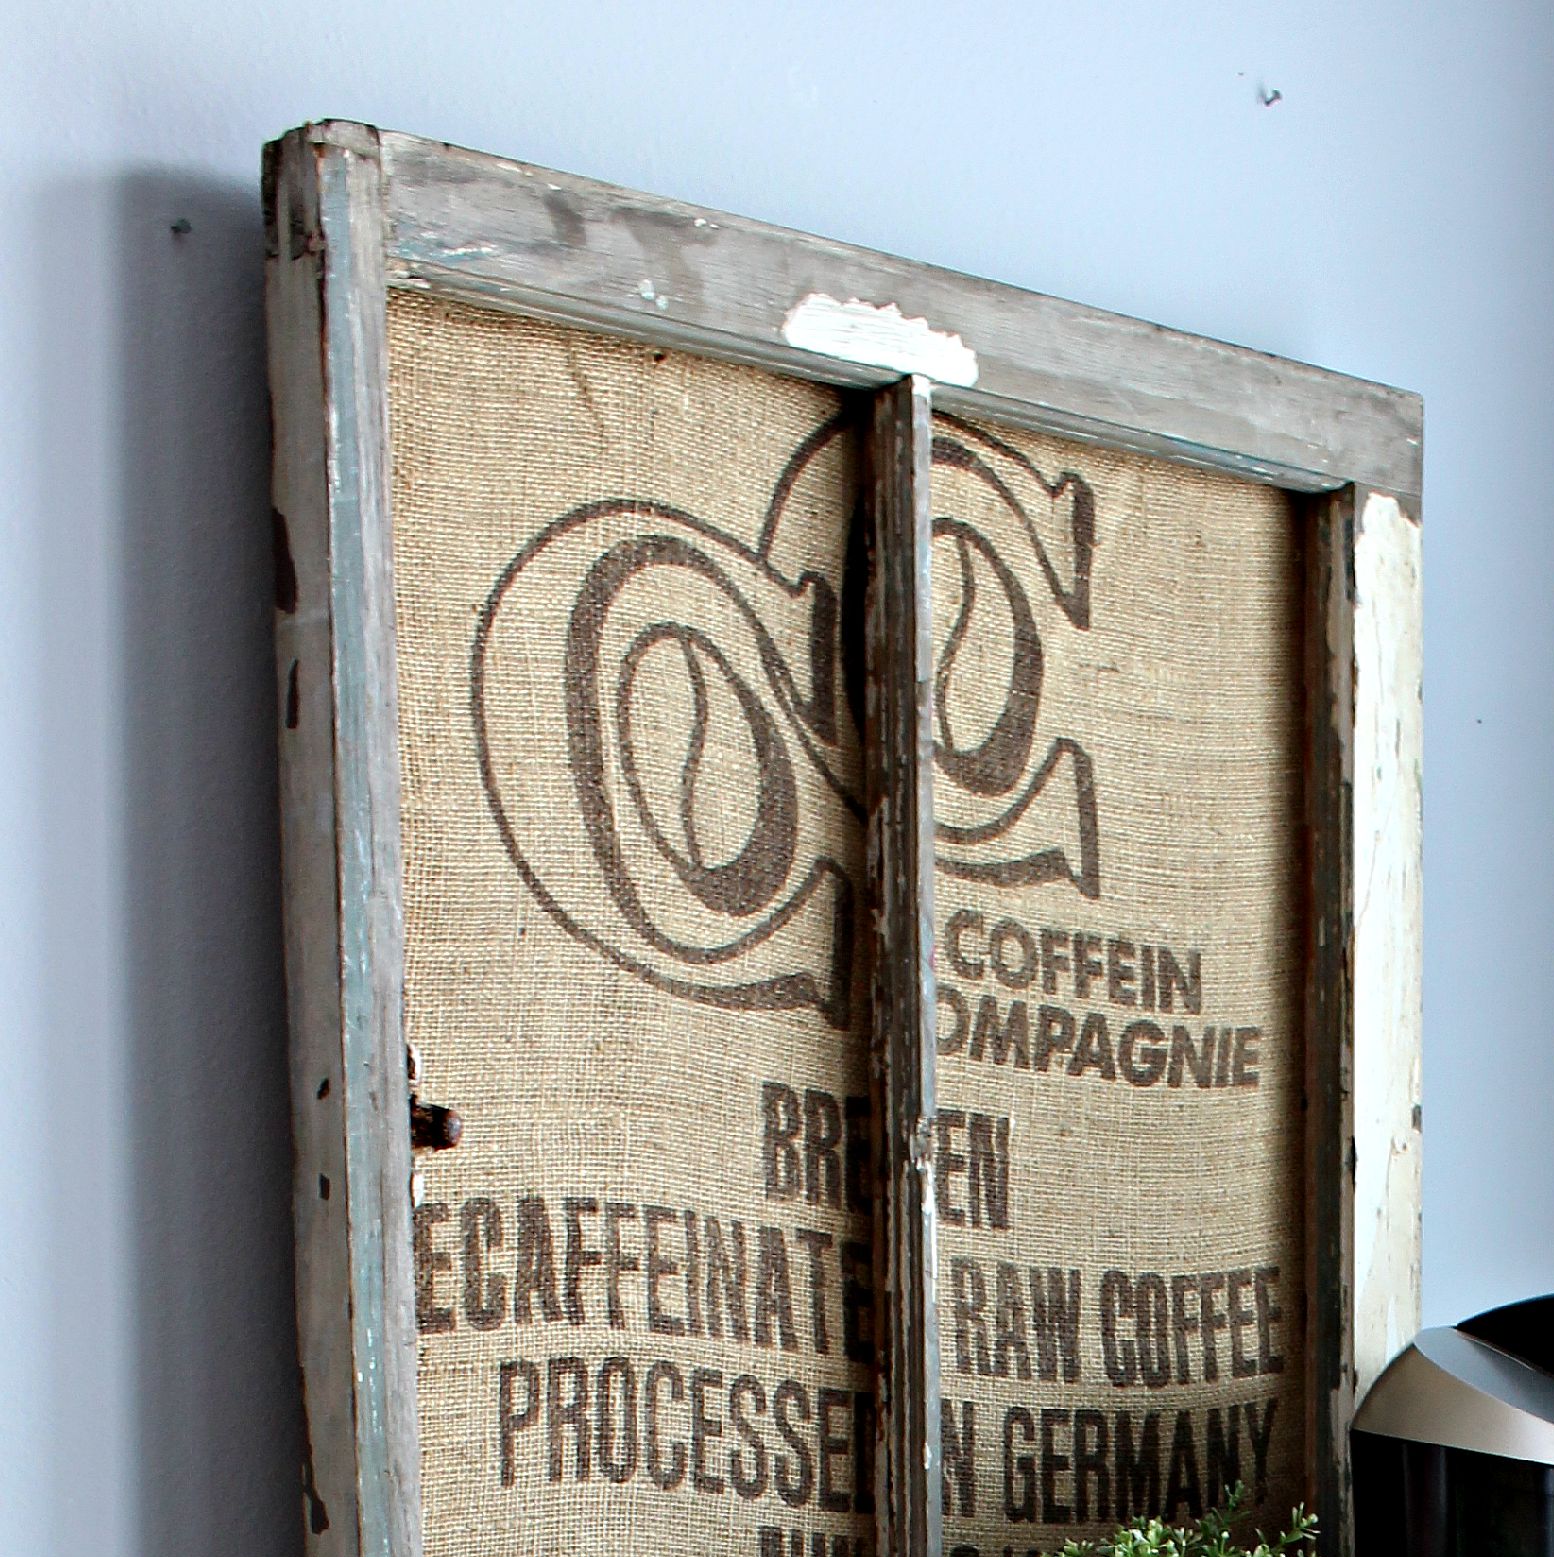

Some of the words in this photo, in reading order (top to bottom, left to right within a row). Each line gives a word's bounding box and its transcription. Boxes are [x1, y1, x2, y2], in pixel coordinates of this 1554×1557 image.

[944, 908, 1202, 1017] COFFEIN
[935, 982, 1264, 1088] OMPAGNIE
[950, 1255, 1082, 1384] RAW
[1099, 1265, 1284, 1388] COFFEE
[1002, 1399, 1281, 1525] GERMANY
